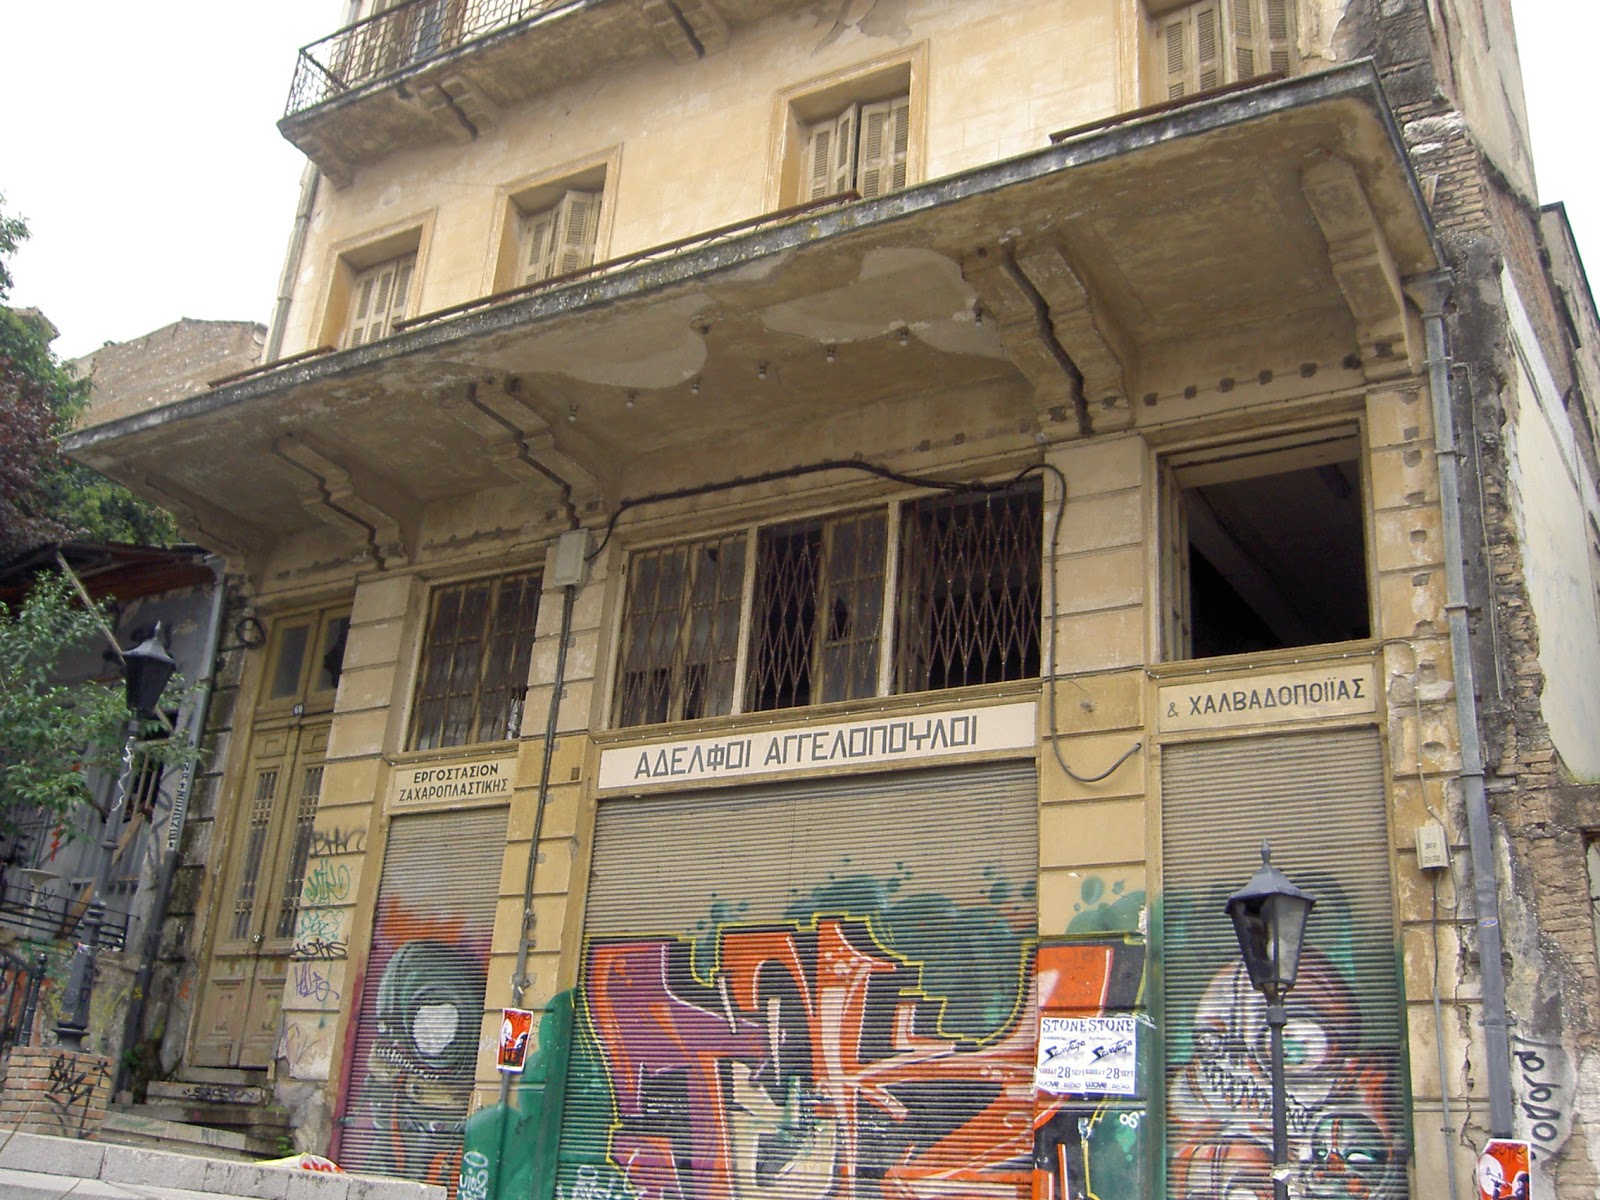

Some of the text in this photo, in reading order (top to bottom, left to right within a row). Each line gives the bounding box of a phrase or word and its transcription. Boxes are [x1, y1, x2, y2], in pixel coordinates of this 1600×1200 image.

[1167, 701, 1179, 718] &
[633, 715, 978, 779] ΑΔΕΛΦΟΙ ΑΓΓΕΛΟΠΟΥΛΟΙ
[413, 763, 499, 784] ΕΡΓΟΣΤΑΣΙΟΝ
[398, 778, 509, 802] ΖΑΧΑΡΟΠΛΑΣΤΙΚΗΣ
[1042, 1019, 1087, 1032] STONE
[1088, 1019, 1134, 1032] STONE
[1057, 1066, 1071, 1079] 28
[1105, 1067, 1120, 1079] 28
